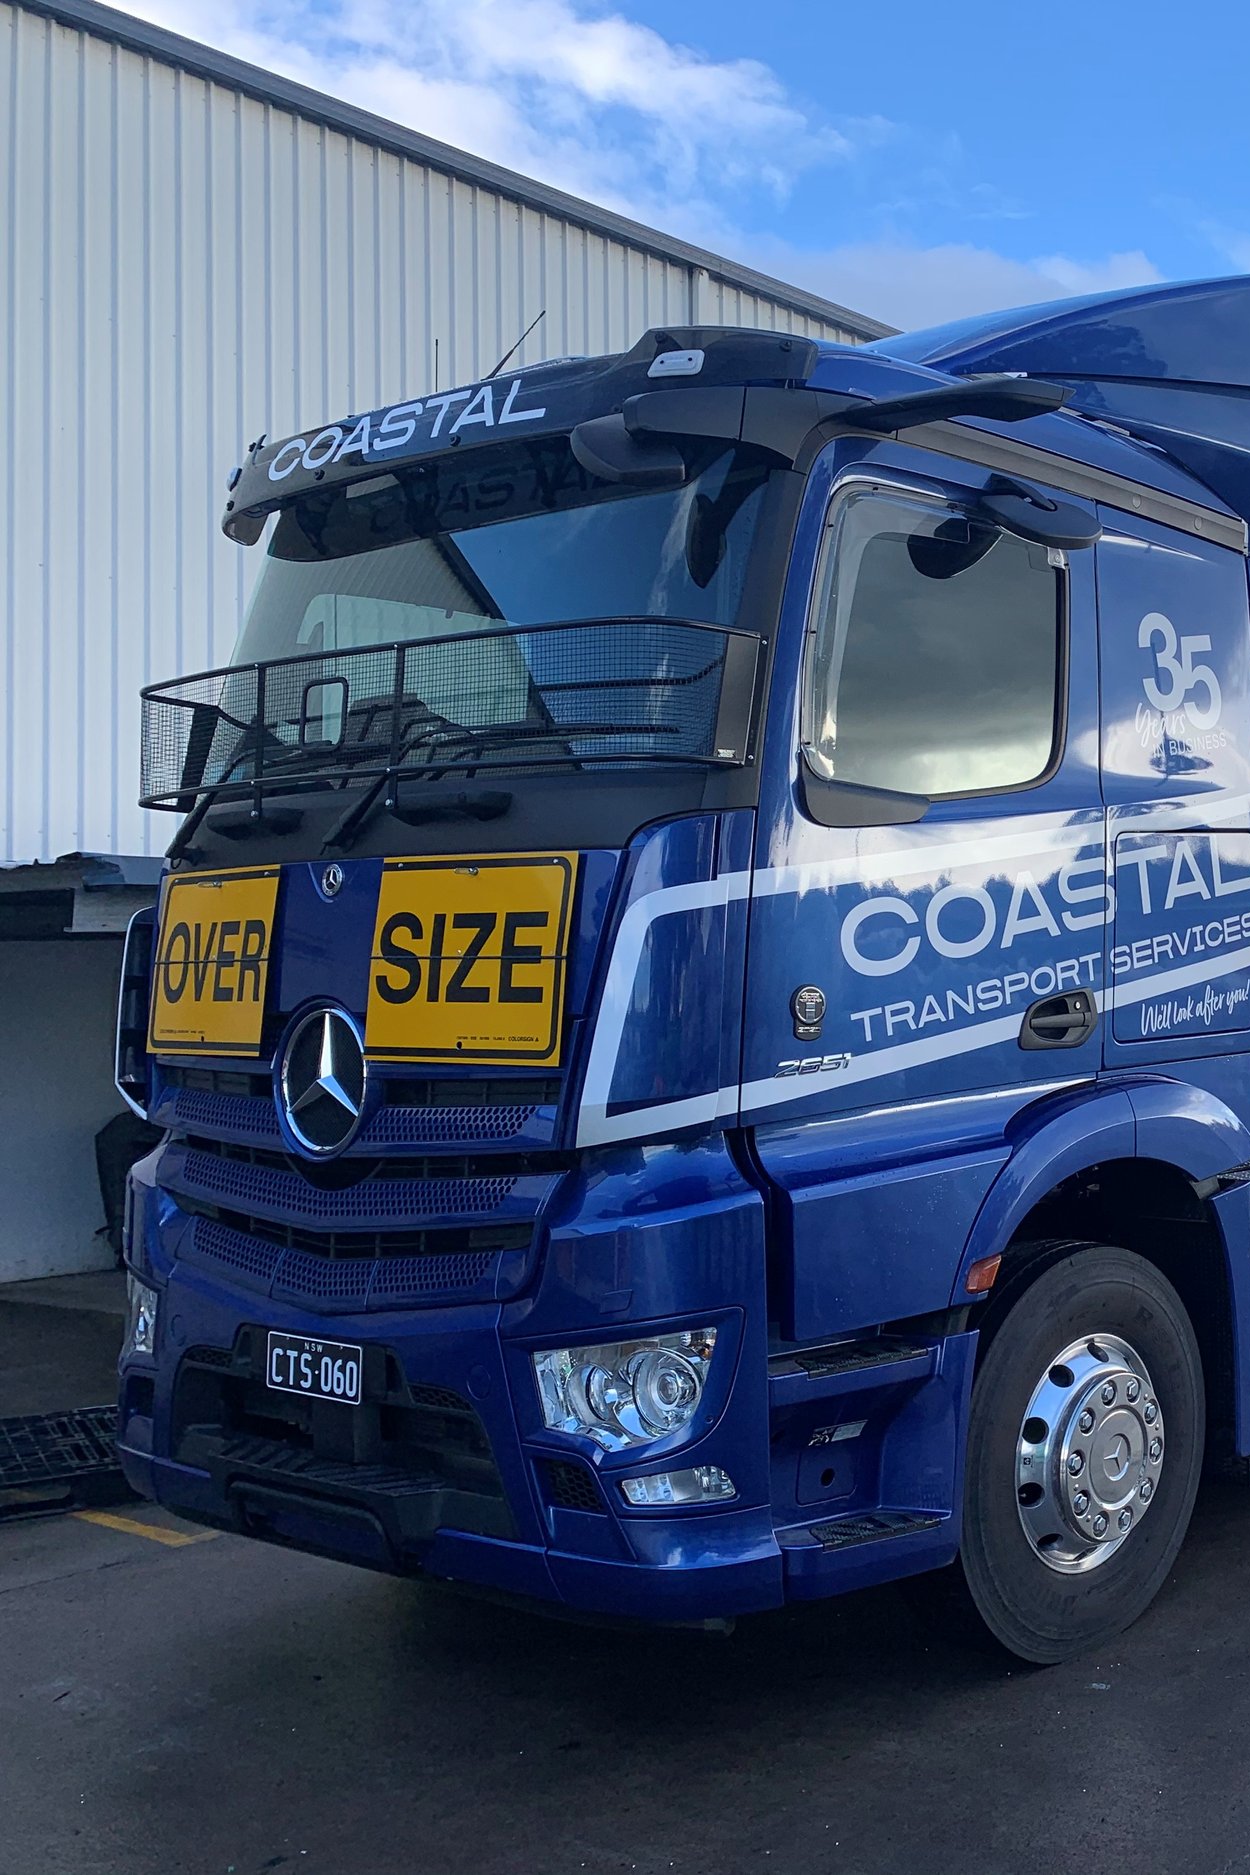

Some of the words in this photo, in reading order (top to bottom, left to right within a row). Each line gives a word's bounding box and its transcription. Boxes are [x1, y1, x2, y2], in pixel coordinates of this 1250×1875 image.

[268, 379, 547, 481] COASTAL
[1138, 612, 1222, 731] 35
[1134, 702, 1186, 748] Years
[1152, 743, 1166, 759] IN
[1169, 733, 1227, 757] BUSINESS
[163, 919, 266, 1004] OVER
[375, 911, 549, 1005] SIZE
[850, 952, 1102, 1042] TRANSPORT
[1141, 1003, 1171, 1036] We'll
[1174, 995, 1194, 1025] look
[1195, 984, 1225, 1026] after
[1226, 979, 1250, 1014] you!
[775, 1052, 851, 1078] 2651
[304, 1342, 323, 1353] NSW
